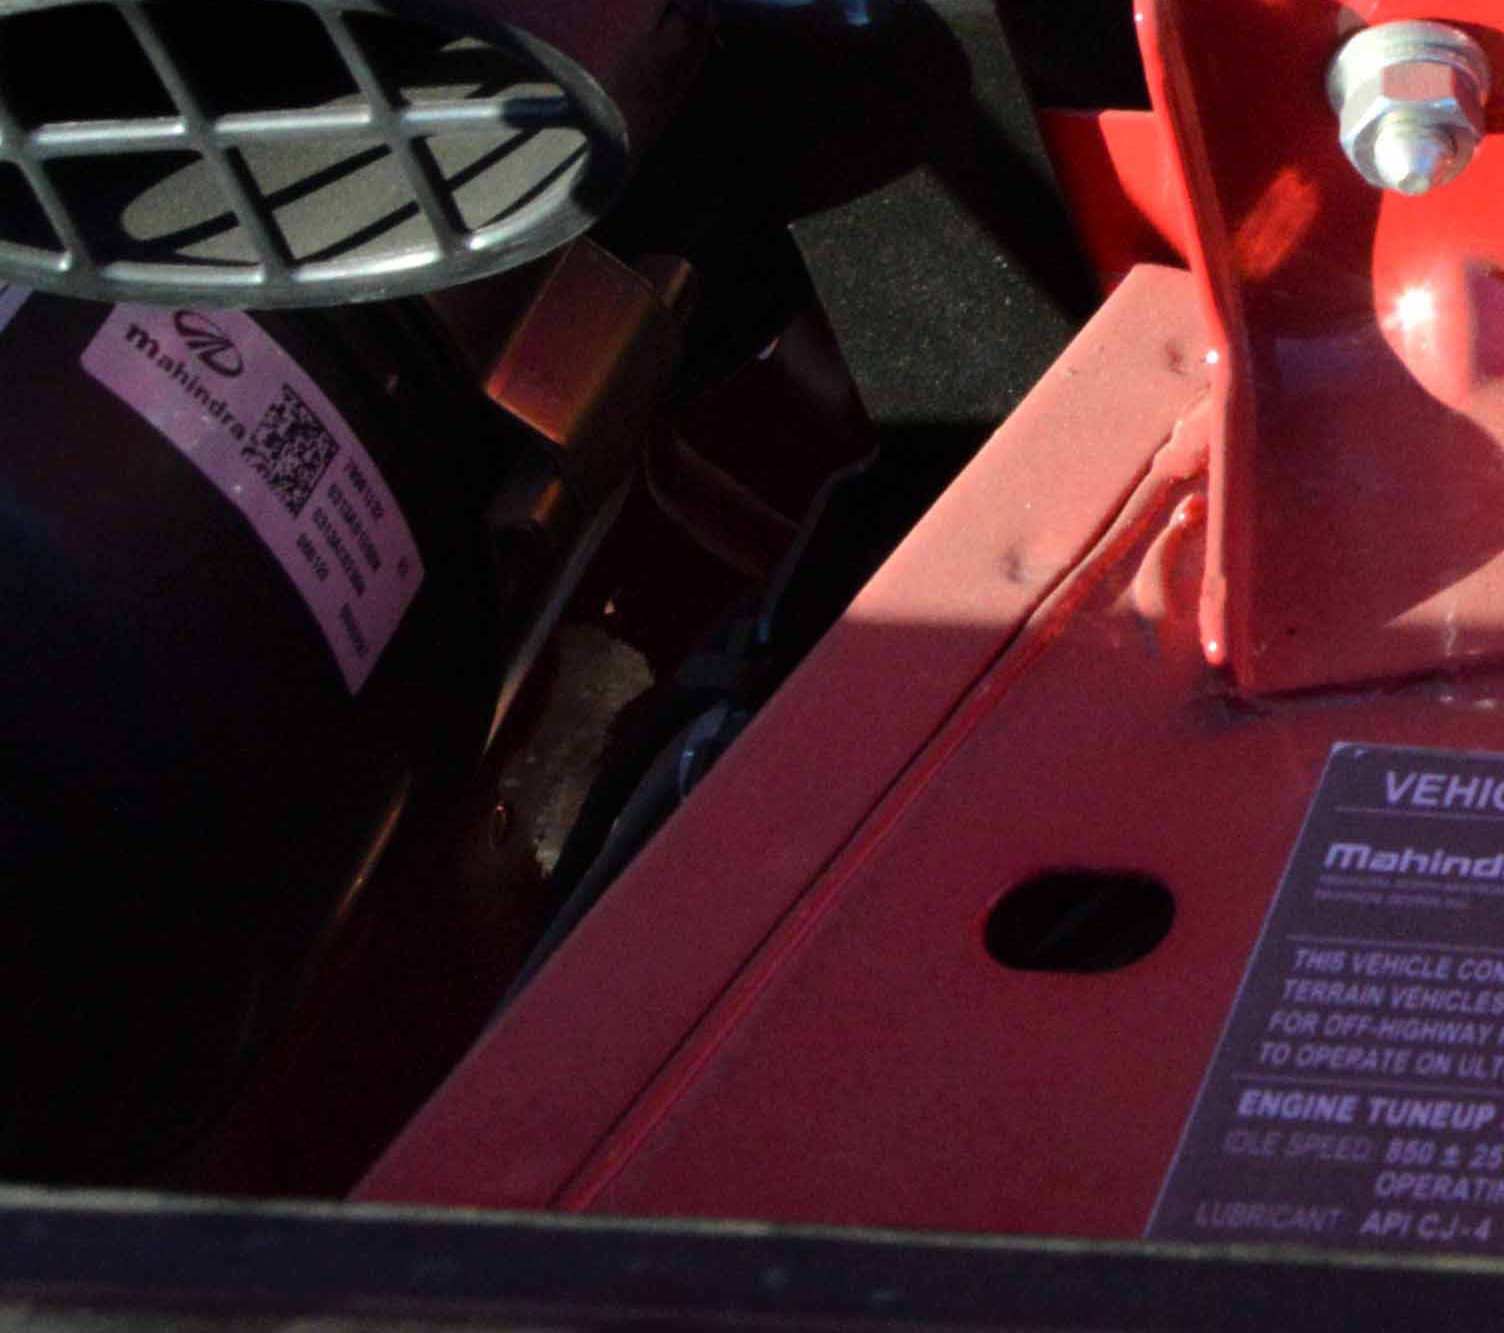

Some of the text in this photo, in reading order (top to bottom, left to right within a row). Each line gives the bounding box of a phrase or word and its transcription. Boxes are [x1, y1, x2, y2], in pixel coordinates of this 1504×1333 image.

[125, 321, 245, 443] mahindra
[1294, 947, 1345, 972] THIS
[1352, 952, 1450, 980] VEHICLE
[1283, 978, 1384, 1005] TERRAIN
[1268, 1009, 1331, 1035] FOR
[1330, 1013, 1493, 1044] OFF-HIGHWAY
[1258, 1041, 1292, 1066] TO
[1295, 1044, 1410, 1073] OPERATE
[1415, 1051, 1452, 1074] ON
[1237, 1090, 1357, 1122] ENGINE
[1369, 1097, 1495, 1129] TUNEUP
[1469, 1142, 1502, 1170] 25
[1359, 1210, 1411, 1235] API
